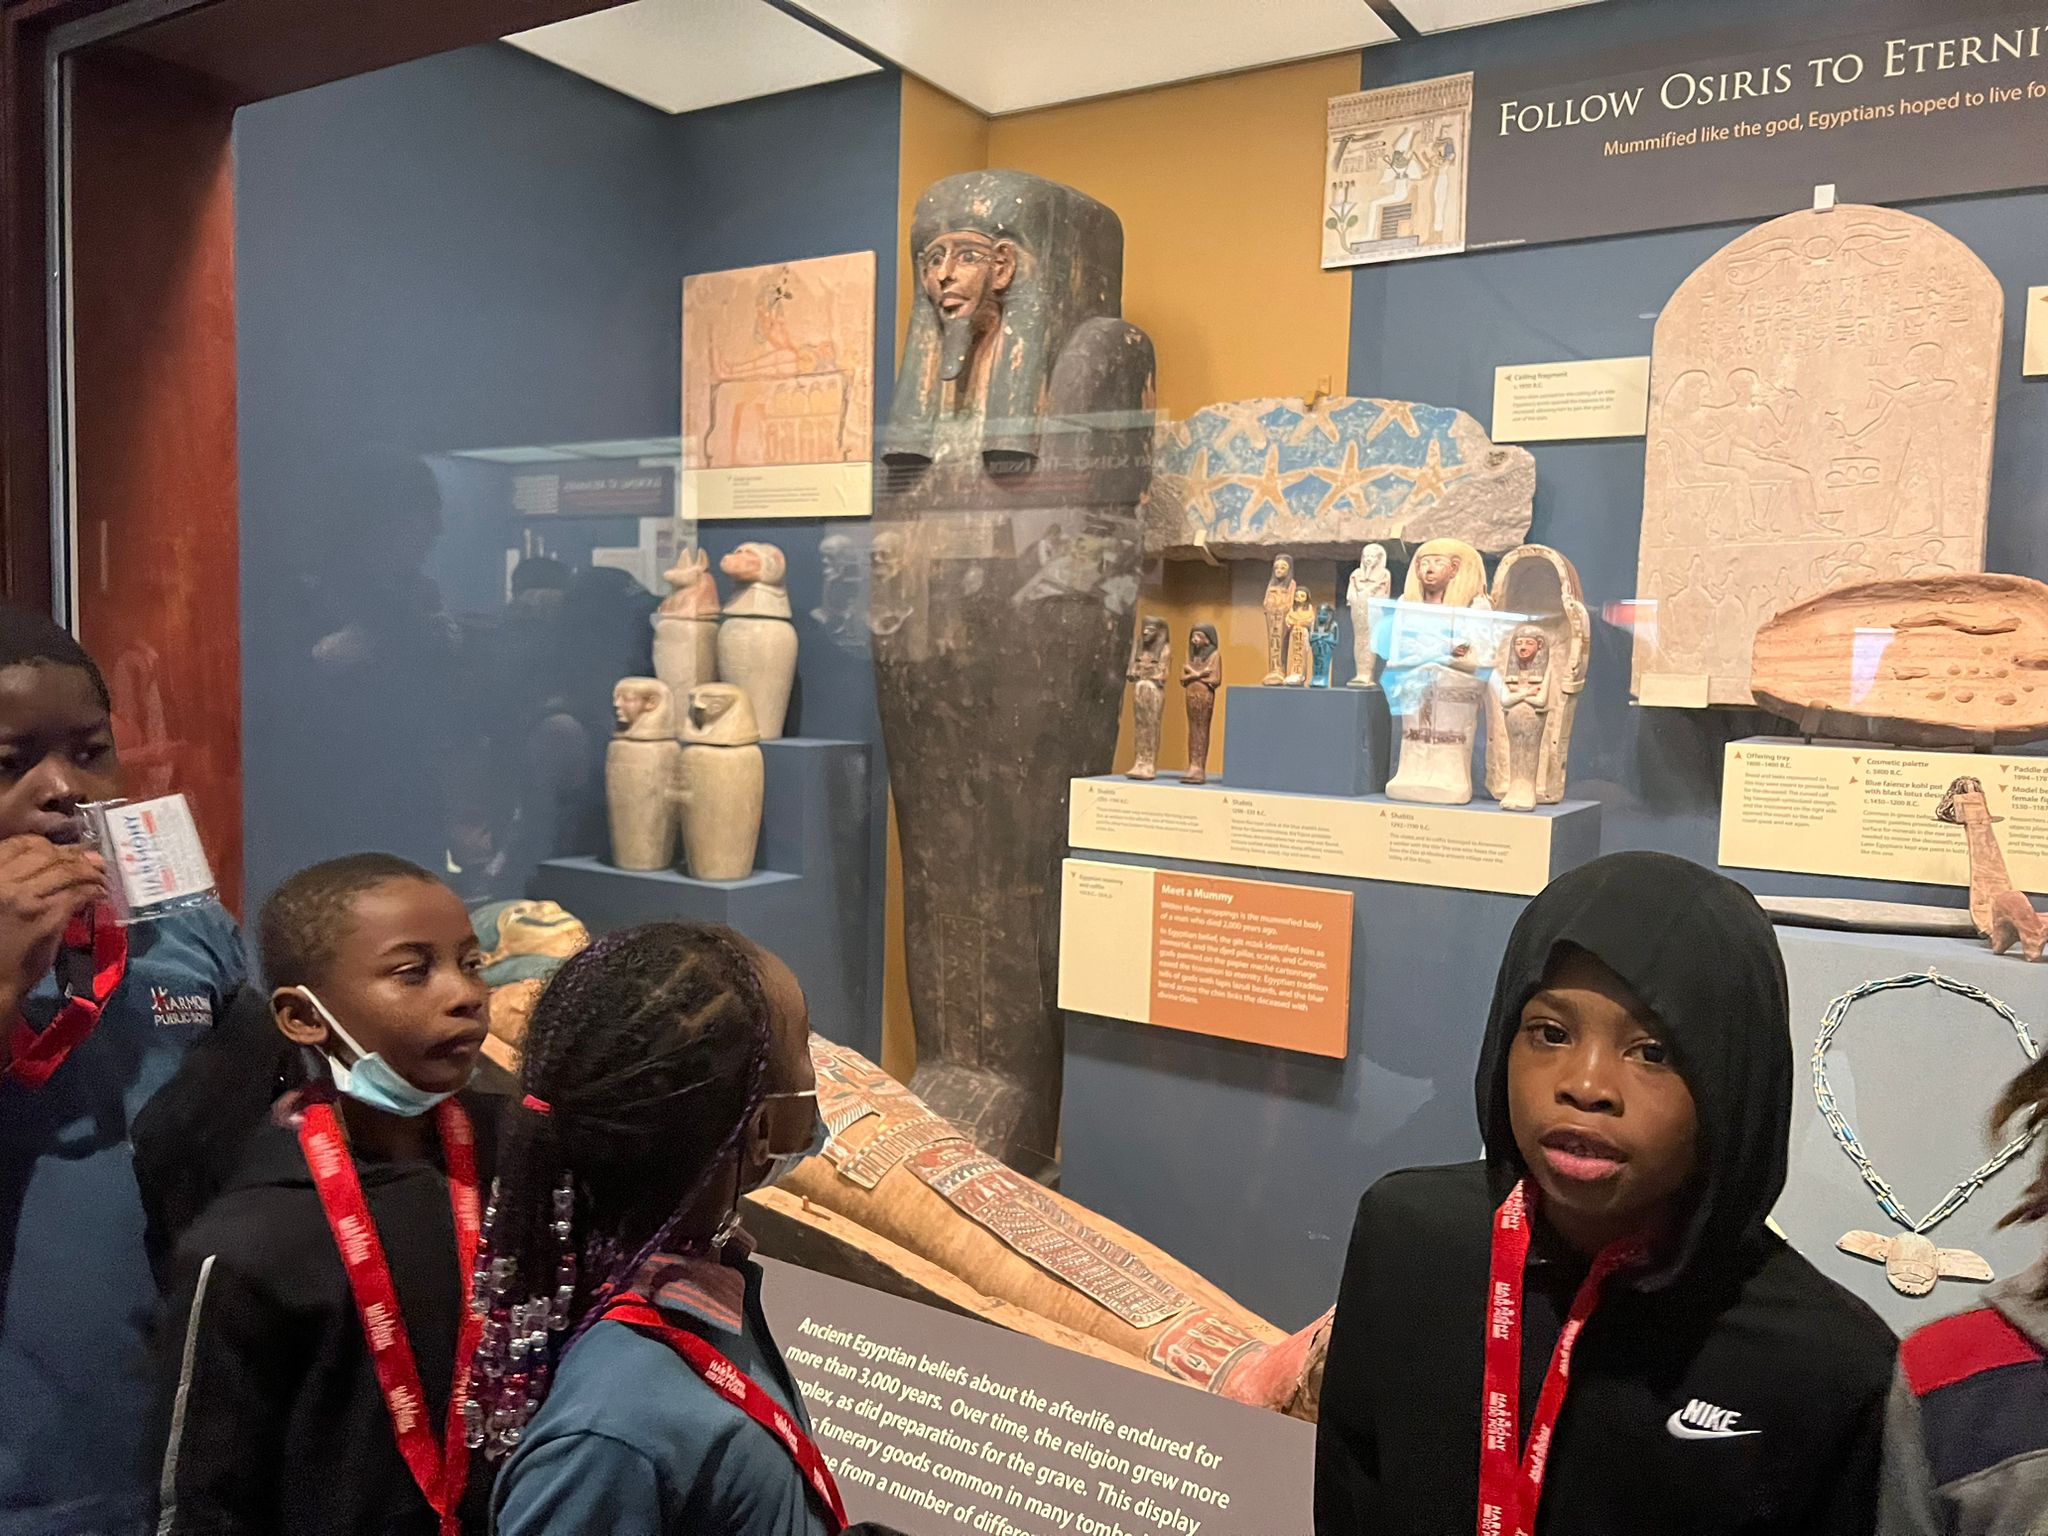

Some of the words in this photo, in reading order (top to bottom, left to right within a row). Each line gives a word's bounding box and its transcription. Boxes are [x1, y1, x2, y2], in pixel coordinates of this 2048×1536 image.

[1499, 87, 1645, 136] FOLLOW
[1660, 63, 1793, 110] OSIRIS
[1808, 54, 1864, 88] TO
[1884, 25, 2048, 78] ETERNI
[1603, 128, 1697, 156] Mummified
[1701, 126, 1729, 143] like
[1734, 121, 1761, 138] the
[1765, 113, 1804, 137] god,
[1808, 102, 1895, 129] Egyptians
[1900, 91, 1960, 116] hoped
[1965, 92, 1984, 107] to
[1989, 86, 2022, 104] live
[2027, 80, 2048, 98] fo
[1865, 779, 1881, 787] Blue
[1867, 758, 1901, 767] Cosmetic
[1902, 760, 1929, 768] palette
[1882, 789, 1902, 797] black
[1161, 883, 1185, 896] Meet
[1186, 888, 1193, 897] a
[1194, 887, 1234, 905] Mummy
[785, 1345, 824, 1369] more
[823, 1355, 858, 1381] than
[857, 1367, 901, 1395] 3,000
[897, 1383, 943, 1411] years.
[950, 1398, 990, 1425] Over
[989, 1412, 1030, 1443] time,
[1034, 1426, 1063, 1452] the
[1063, 1440, 1131, 1475] religion
[1130, 1462, 1180, 1491] grew
[1180, 1478, 1232, 1510] more
[798, 1316, 854, 1348] Ancient
[852, 1333, 918, 1370] Egyptian
[918, 1353, 970, 1386] beliefs
[969, 1373, 1018, 1403] about
[1019, 1386, 1048, 1413] the
[1048, 1400, 1116, 1435] afterlife
[1117, 1424, 1194, 1461] endured
[1194, 1444, 1224, 1470] for
[1681, 1398, 1742, 1432] NIKE
[795, 1378, 835, 1408] plex,
[835, 1394, 855, 1411] as
[854, 1397, 884, 1422] did
[879, 1411, 981, 1456] preparations
[980, 1440, 1007, 1466] for
[1006, 1452, 1036, 1477] the
[1035, 1465, 1088, 1497] grave.
[1096, 1480, 1134, 1511] This
[1133, 1496, 1202, 1536] display
[817, 1416, 883, 1457] funerary
[880, 1444, 932, 1473] goods
[932, 1463, 1007, 1500] common
[1005, 1485, 1023, 1508] in
[1024, 1495, 1075, 1529] many
[1075, 1512, 1133, 1536] tomb
[838, 1457, 876, 1487] from
[876, 1476, 889, 1492] a
[888, 1480, 954, 1516] number
[953, 1505, 977, 1524] of
[973, 1510, 1036, 1536] differ
